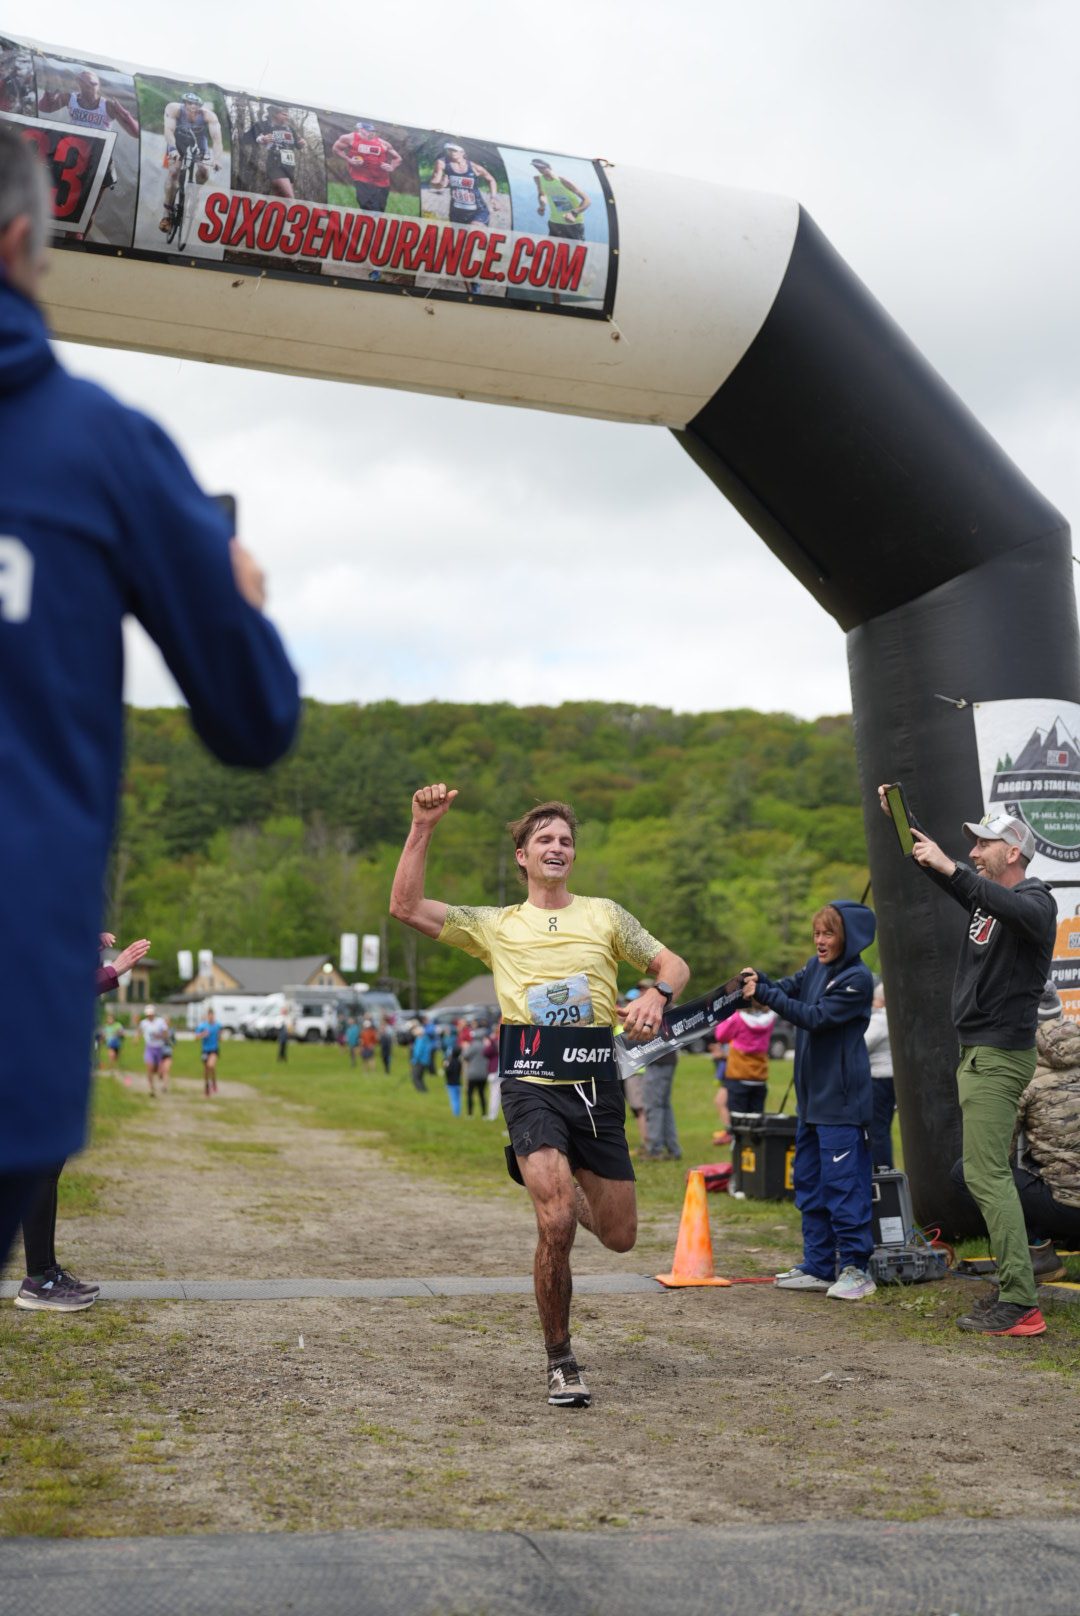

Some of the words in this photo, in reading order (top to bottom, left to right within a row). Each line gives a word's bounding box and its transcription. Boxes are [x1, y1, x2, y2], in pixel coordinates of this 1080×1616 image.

[198, 192, 588, 291] SIX03ENDURANCE.COM
[546, 1005, 581, 1026] 229
[563, 1047, 611, 1063] USATF
[514, 1060, 544, 1069] USATF
